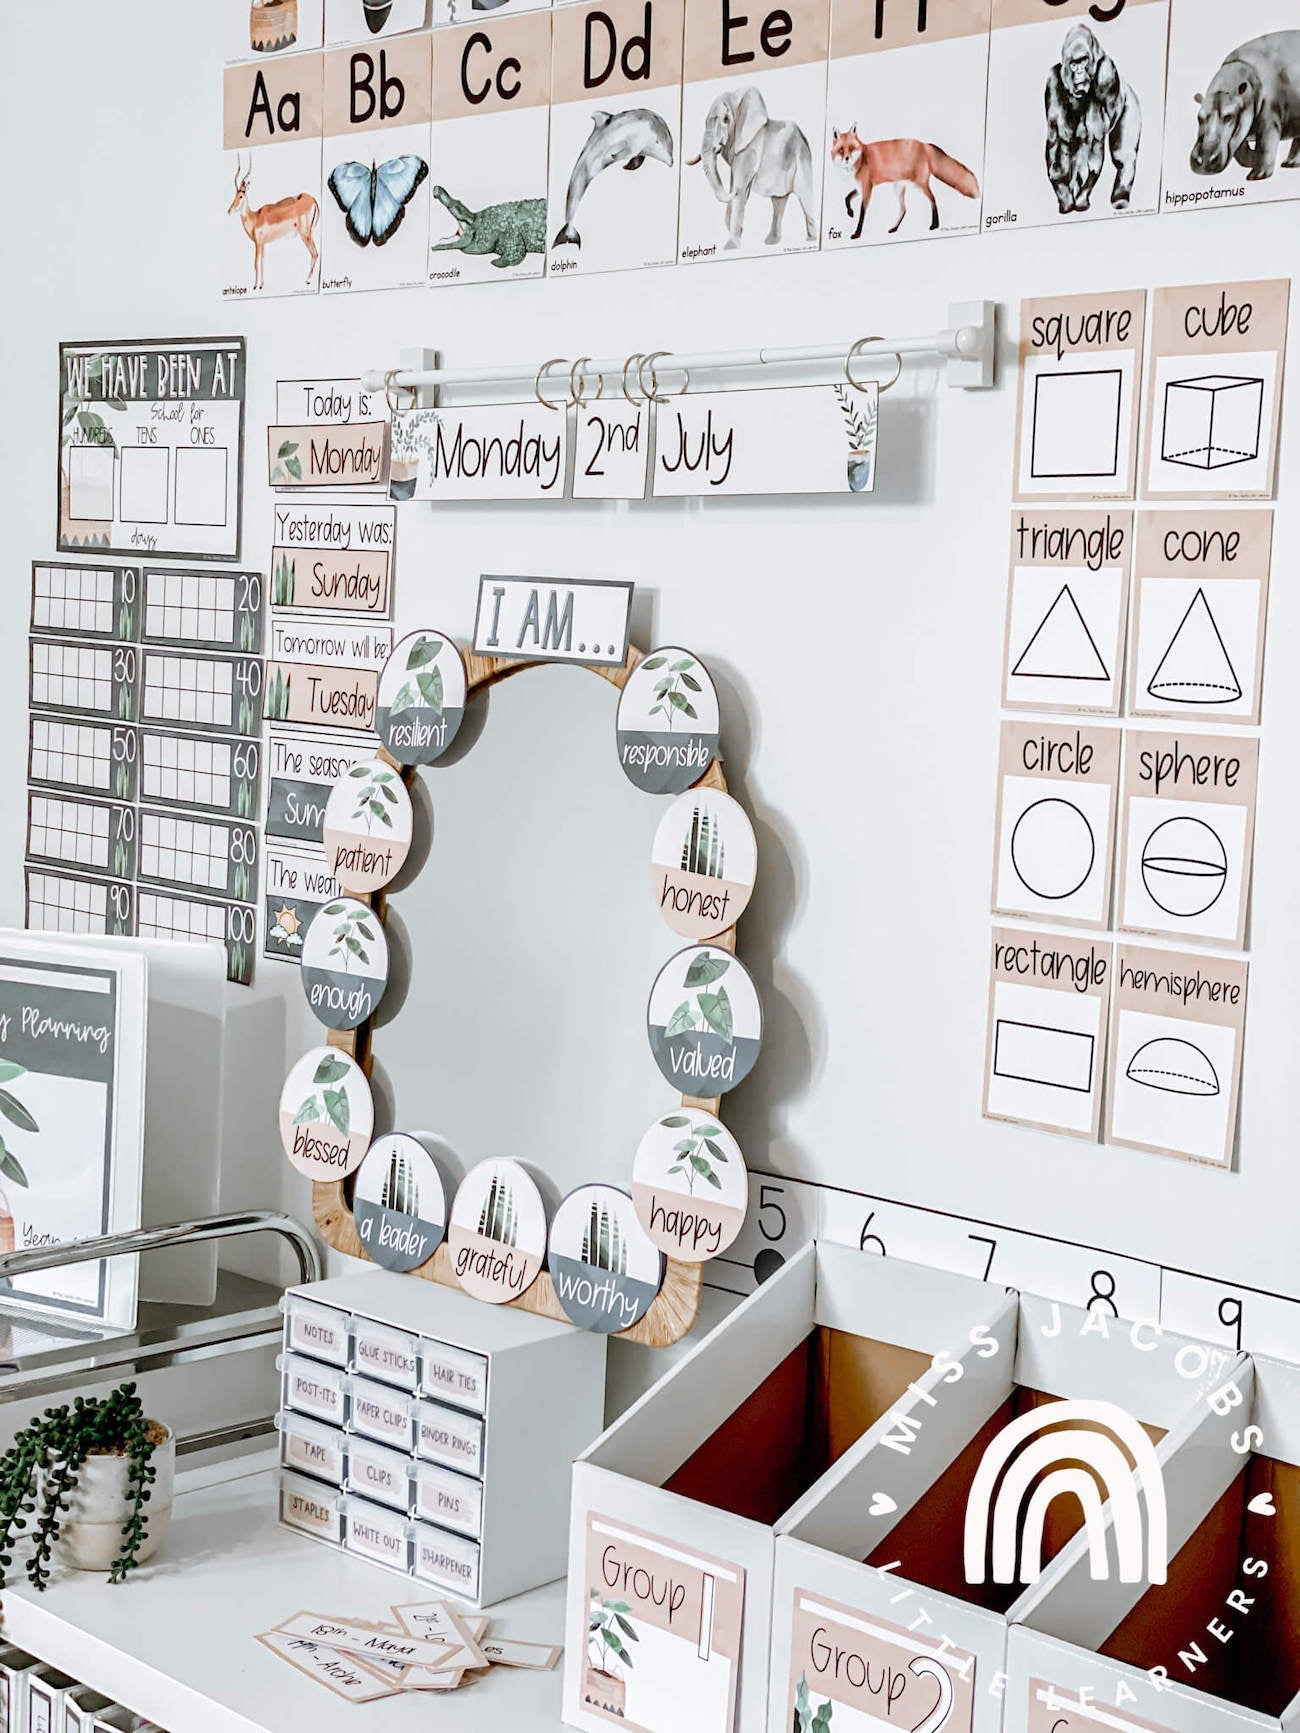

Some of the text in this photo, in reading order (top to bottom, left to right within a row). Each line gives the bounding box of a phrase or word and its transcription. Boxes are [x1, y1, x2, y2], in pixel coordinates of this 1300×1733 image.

[584, 1, 652, 89] Dd
[721, 0, 793, 66] Ee
[350, 49, 405, 124] Bb
[461, 32, 521, 105] Cc
[245, 70, 300, 138] Aa
[1165, 184, 1245, 207] hippopotamus
[828, 227, 842, 240] fox
[985, 210, 1017, 226] gorilla
[550, 259, 578, 272] dolphin
[681, 243, 716, 259] elephant
[222, 285, 247, 296] antelope
[322, 277, 353, 290] butterfly
[429, 267, 460, 281] crocodile
[1185, 292, 1252, 338] cube
[1032, 309, 1131, 360] square
[67, 353, 238, 398] WE HAVE BEEN AT
[151, 402, 205, 424] School for
[304, 387, 372, 423] Today is:
[136, 427, 157, 445] TENS
[190, 427, 215, 445] ONES
[434, 419, 560, 489] Monday
[585, 411, 640, 476] 2nd
[662, 409, 734, 486] July
[310, 438, 380, 480] Monday
[277, 512, 393, 549] Yesterday was:
[1017, 515, 1124, 571] triangle
[1164, 530, 1240, 562] cone
[121, 570, 136, 604] 10
[237, 575, 261, 612] 20
[311, 562, 380, 609] Sunday
[487, 587, 616, 656] I AM...
[276, 629, 346, 656] Tomorrow
[352, 635, 370, 659] will
[114, 649, 136, 683] 30
[235, 660, 261, 697] 40
[307, 677, 374, 728] Tuesday
[112, 727, 136, 762] 50
[389, 717, 448, 748] resilient
[234, 744, 258, 780] 60
[274, 743, 302, 773] The
[623, 739, 708, 773] responsible
[1023, 730, 1094, 775] circle
[1139, 741, 1240, 794] sphere
[112, 806, 134, 841] 70
[230, 828, 256, 865] 80
[334, 842, 392, 876] patient
[271, 860, 297, 888] The
[111, 886, 129, 921] 90
[662, 874, 730, 921] honest
[228, 908, 255, 944] 100
[995, 940, 1107, 993] rectangle
[1120, 958, 1241, 1005] hemisphere
[311, 982, 371, 1019] enough
[22, 1006, 112, 1053] Planning
[670, 1041, 736, 1082] valued
[293, 1126, 350, 1170] blessed
[650, 1195, 722, 1252] happy
[757, 1185, 787, 1241] 5
[360, 1213, 427, 1258] a leader
[455, 1244, 527, 1291] grateful
[968, 1234, 997, 1282] 7
[558, 1268, 640, 1325] worthy
[304, 1323, 333, 1345] NOTES
[358, 1341, 414, 1372] GLUE STICKS
[297, 1378, 336, 1404] POST-ITS
[433, 1365, 476, 1391] HAIR TIES
[356, 1399, 407, 1429] PAPER CLIPS
[303, 1441, 326, 1462] TAPE
[421, 1425, 477, 1456] BINDER RINGS
[366, 1465, 391, 1486] CLIPS
[292, 1496, 330, 1522] STAPLES
[438, 1492, 460, 1512] PINS
[353, 1521, 402, 1553] WHITE OUT
[422, 1548, 472, 1578] SHARPENER
[602, 1544, 714, 1661] Group 1
[811, 1628, 906, 1716] Group
